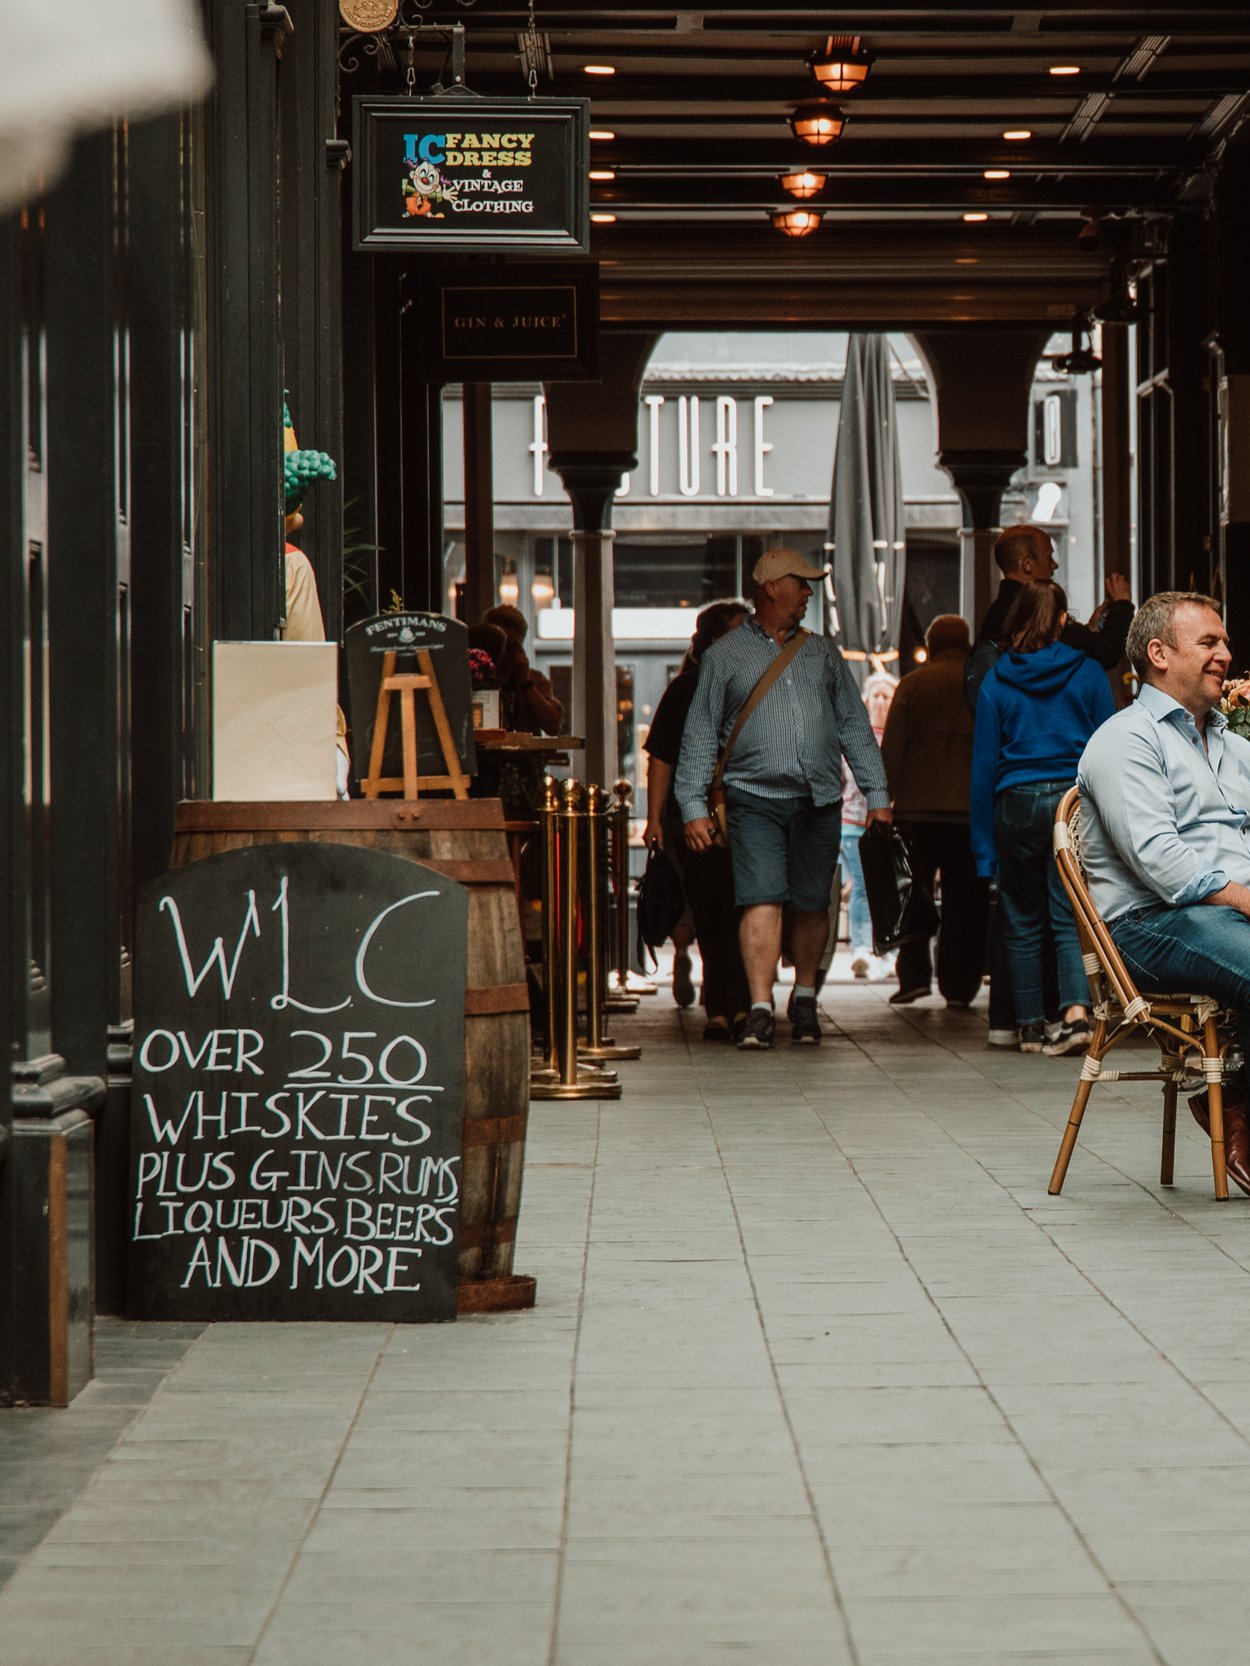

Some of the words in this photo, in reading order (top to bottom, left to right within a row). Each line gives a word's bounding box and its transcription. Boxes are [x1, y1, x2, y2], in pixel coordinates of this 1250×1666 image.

[403, 133, 446, 165] IC
[445, 133, 535, 149] FANCY
[446, 151, 532, 166] DRESS
[452, 179, 524, 194] VINTAGE
[482, 169, 492, 178] &
[452, 199, 534, 213] CLOTHING
[455, 316, 487, 328] GIN
[494, 316, 505, 328] &
[365, 616, 448, 636] FENTIMANS
[139, 1028, 264, 1075] OVER
[287, 1030, 428, 1085] 250
[143, 1090, 433, 1146] WHISKIES
[136, 1150, 236, 1198] PLUS
[343, 1198, 457, 1246] BEERS
[181, 1236, 281, 1289] AND
[289, 1235, 422, 1294] MORE
